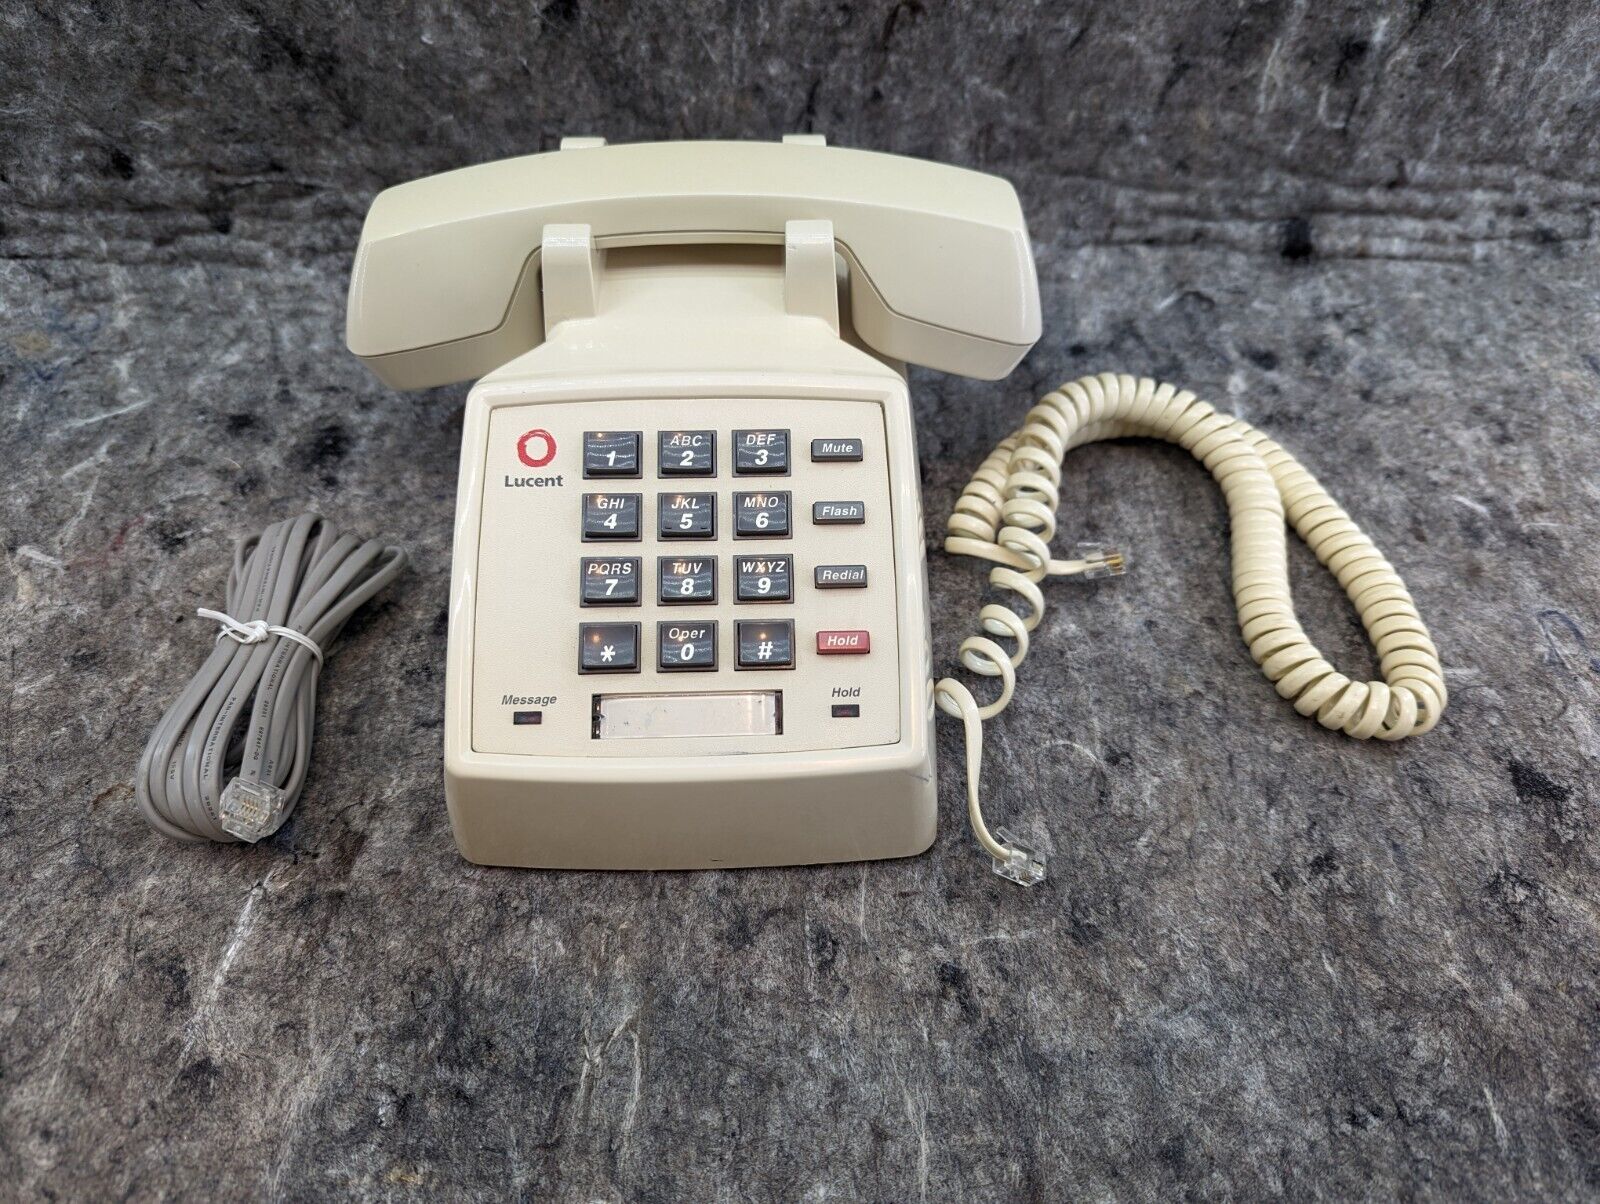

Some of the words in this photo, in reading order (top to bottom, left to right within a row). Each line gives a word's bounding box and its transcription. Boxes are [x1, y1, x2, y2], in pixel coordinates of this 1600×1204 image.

[670, 434, 702, 447] ABC
[745, 433, 776, 446] DEF
[822, 442, 854, 454] Mute
[605, 450, 616, 466] 1
[679, 450, 694, 466] 2
[754, 448, 769, 465] 3
[504, 474, 563, 488] Lucent
[597, 497, 625, 510] GHI
[671, 497, 699, 510] JKL
[744, 496, 779, 508] MNO
[822, 505, 857, 516] Flash
[603, 513, 617, 530] 4
[679, 513, 693, 530] 5
[755, 512, 769, 529] 6
[588, 562, 632, 576] PQRS
[672, 562, 703, 575] TUV
[741, 560, 786, 573] WXYZ
[822, 569, 864, 581] Redial
[604, 579, 618, 596] 7
[680, 578, 695, 595] 8
[757, 577, 772, 594] 9
[669, 627, 705, 641] Oper
[827, 635, 858, 646] Hold
[680, 643, 694, 661] 0
[831, 686, 860, 698] Hold
[501, 694, 557, 707] Message
